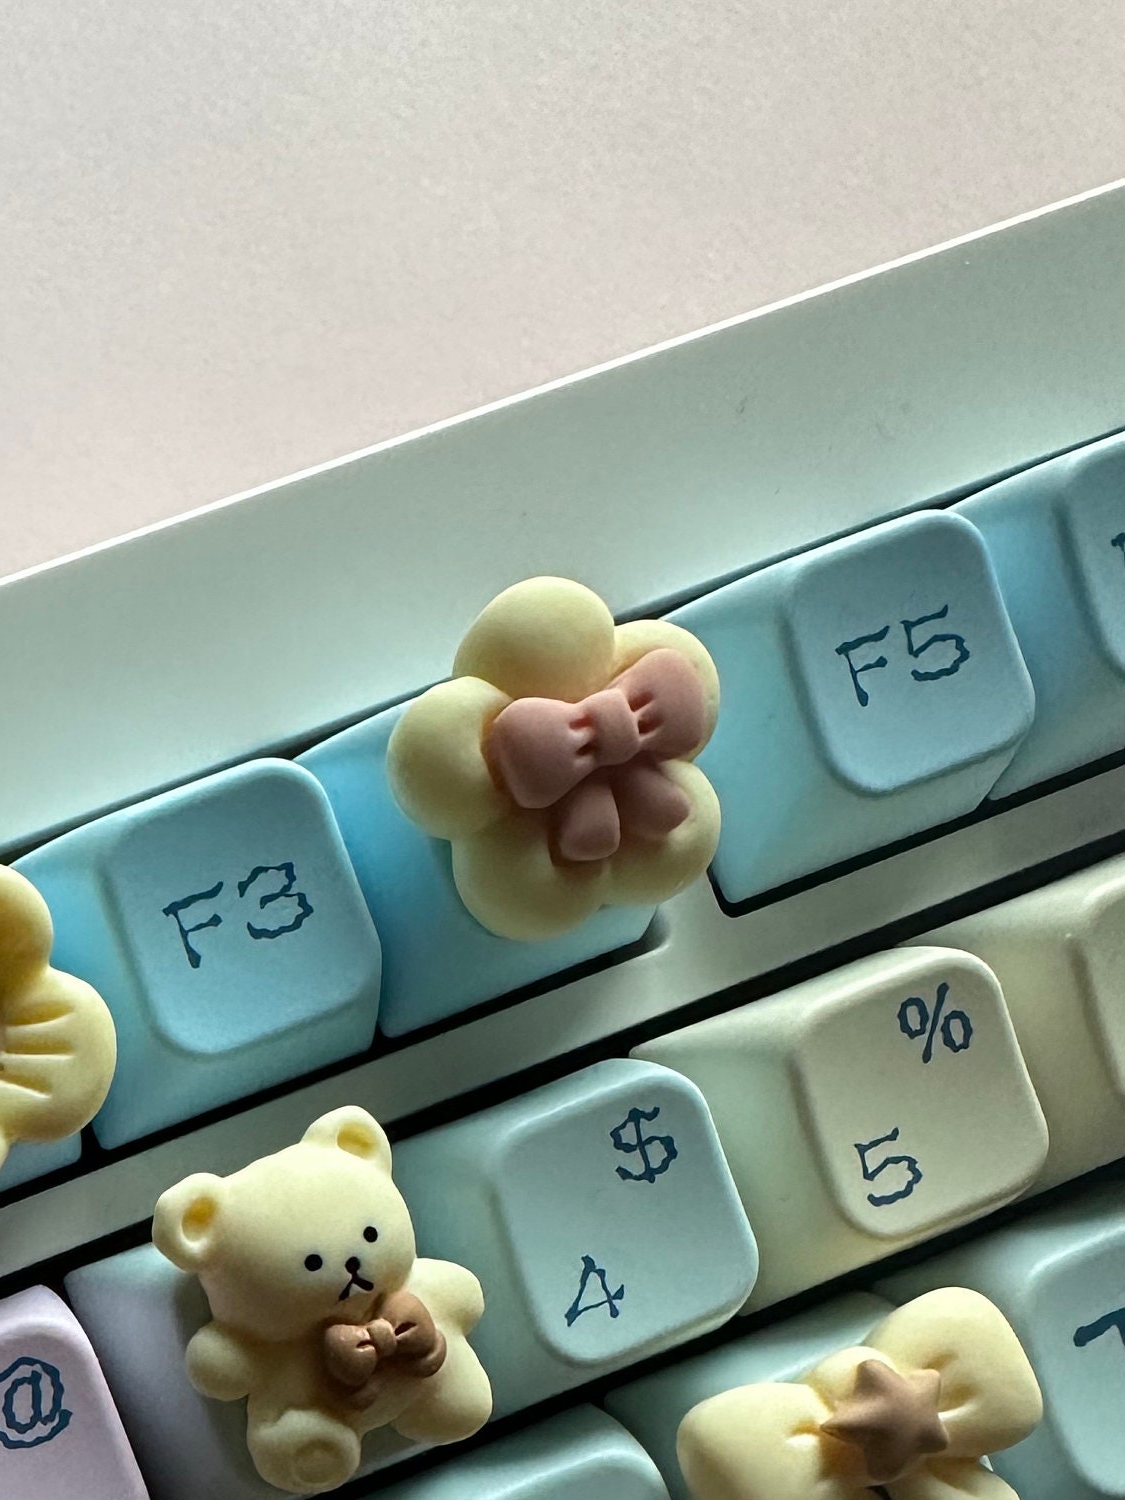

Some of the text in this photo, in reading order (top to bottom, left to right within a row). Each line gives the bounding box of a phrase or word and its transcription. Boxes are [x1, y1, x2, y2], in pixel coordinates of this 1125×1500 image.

[835, 604, 970, 706] F5
[163, 862, 314, 968] F3
[897, 982, 973, 1063] %
[610, 1107, 678, 1183] $
[855, 1127, 922, 1205] 5
[565, 1255, 624, 1327] 4
